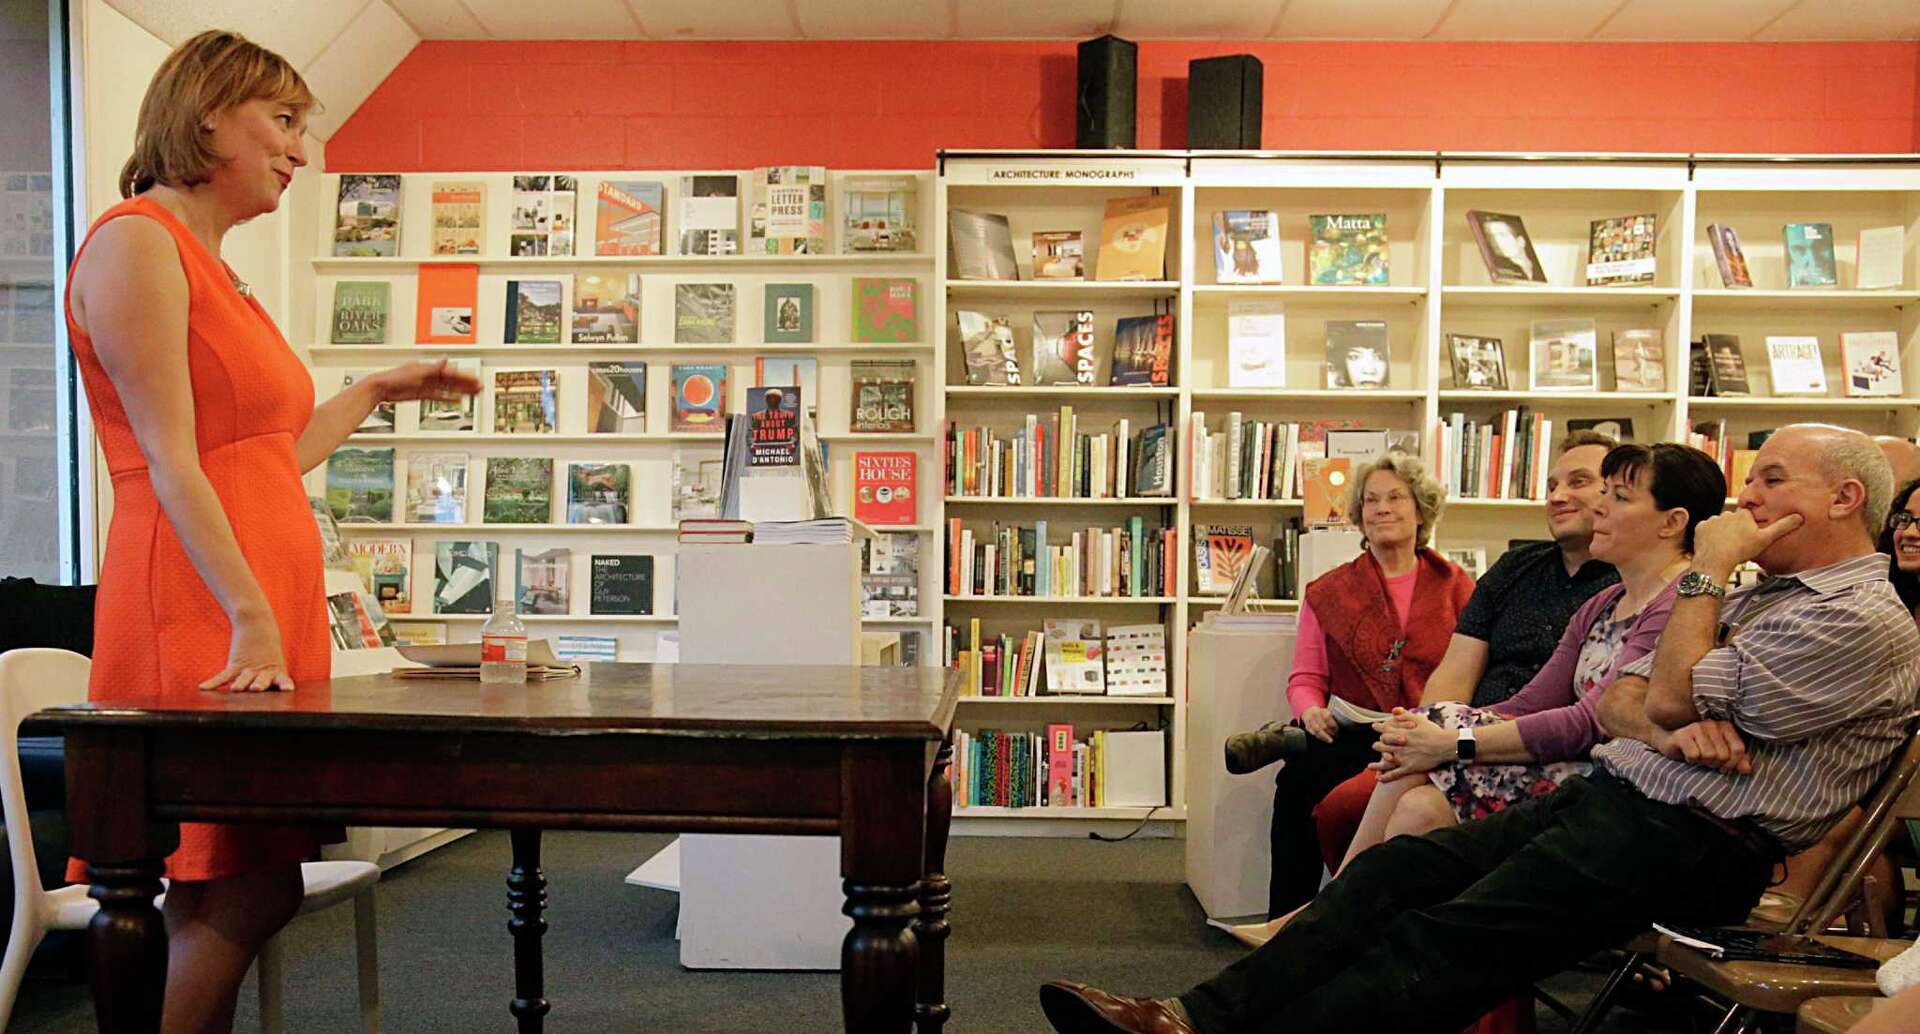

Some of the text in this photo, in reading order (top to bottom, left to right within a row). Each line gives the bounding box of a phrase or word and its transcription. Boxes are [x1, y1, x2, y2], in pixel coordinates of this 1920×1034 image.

[993, 170, 1135, 179] ARCHITECTURE MONOGRAPHS
[771, 194, 804, 205] LETTER
[771, 206, 803, 216] PRESS
[1326, 216, 1371, 230] Matta
[340, 311, 381, 320] RIVER
[339, 321, 381, 331] OAKS
[1077, 311, 1094, 384] SPACES
[1152, 314, 1173, 383] SPACES
[856, 407, 911, 420] ROUGH
[761, 420, 785, 428] ABOUT
[752, 428, 794, 441] TRUMP
[755, 448, 790, 456] MICHAEL
[752, 456, 794, 464] D'ANTONIO
[858, 456, 911, 468] SIXTIES
[1152, 436, 1165, 486] Houston
[860, 468, 911, 480] HOUSE
[1209, 525, 1250, 535] MATISSE
[351, 543, 406, 557] MODERN
